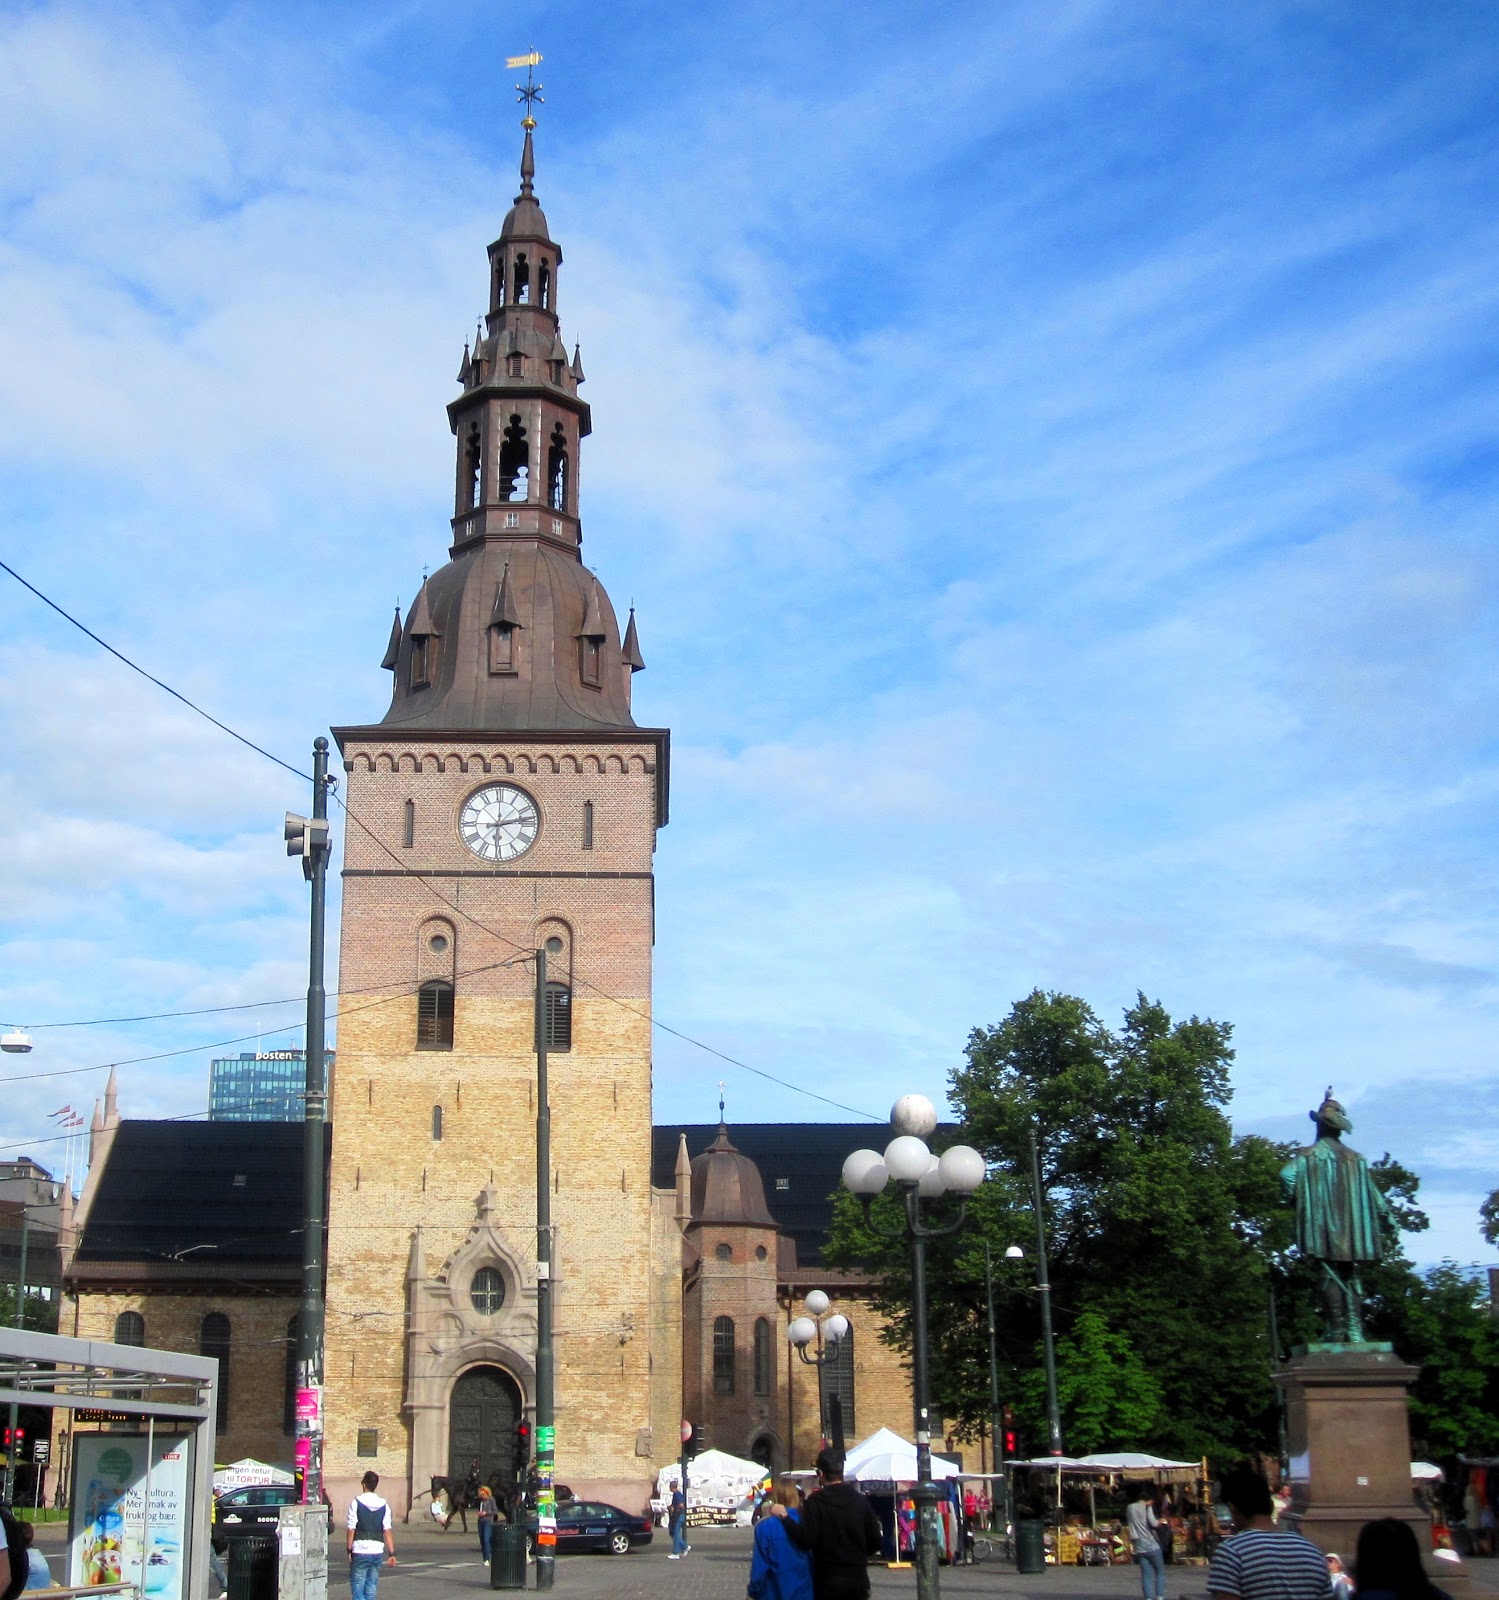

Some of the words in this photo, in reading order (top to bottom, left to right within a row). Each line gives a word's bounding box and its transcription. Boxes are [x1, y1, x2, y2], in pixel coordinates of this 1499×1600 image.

[255, 1052, 292, 1060] posten
[236, 1475, 270, 1484] TORTUR
[126, 1488, 138, 1498] Ny
[145, 1488, 176, 1498] ultura.
[126, 1500, 143, 1508] Mer
[126, 1511, 145, 1520] frukt
[148, 1513, 157, 1522] og
[159, 1511, 176, 1520] bær.
